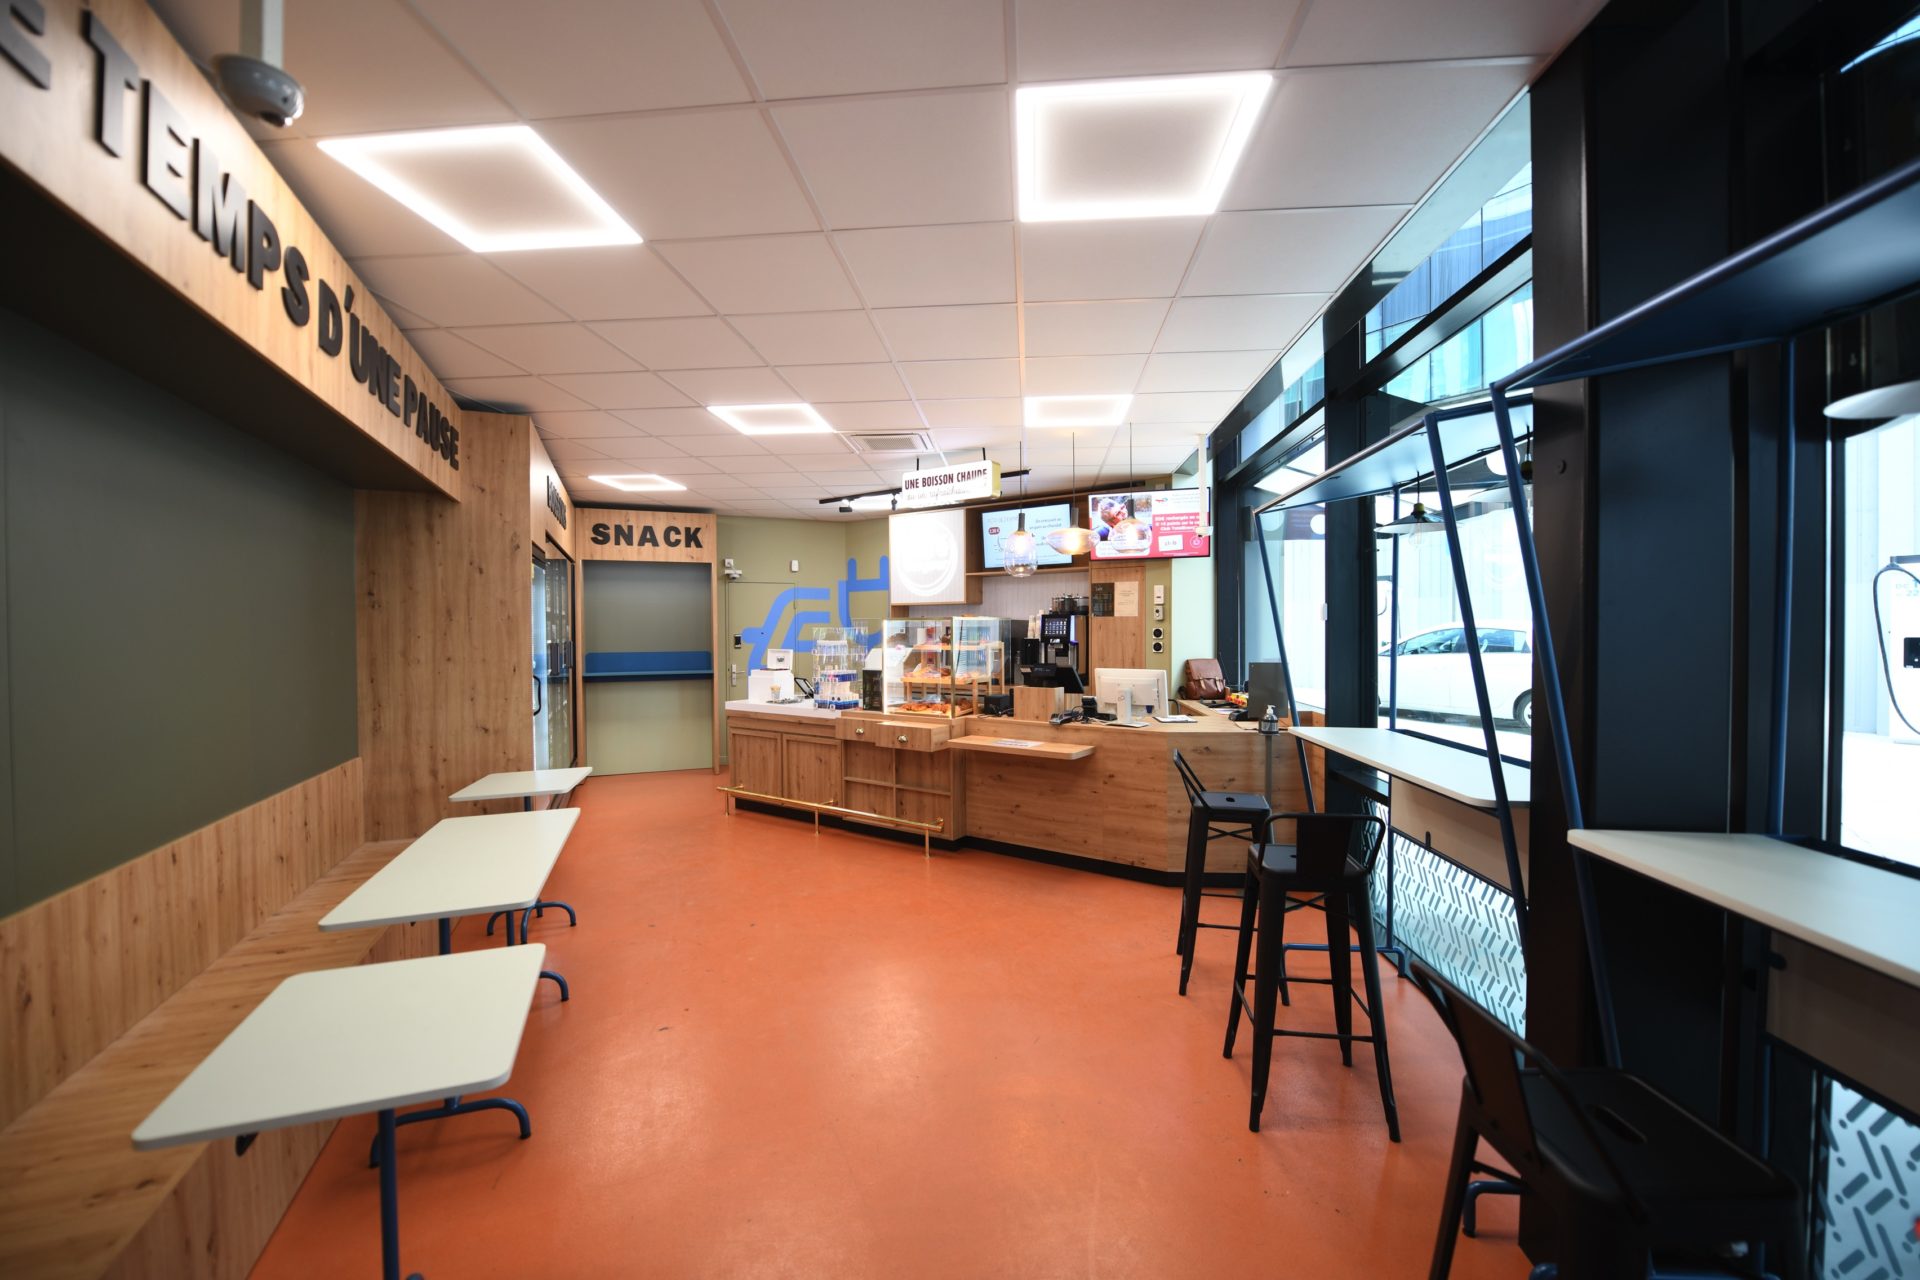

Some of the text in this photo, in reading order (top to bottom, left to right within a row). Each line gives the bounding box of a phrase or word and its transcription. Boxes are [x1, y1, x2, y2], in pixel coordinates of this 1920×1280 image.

[80, 9, 310, 328] TEMPS
[317, 278, 402, 418] D'UNE
[403, 373, 460, 471] PAUSE
[904, 478, 920, 490] UNE
[921, 473, 954, 488] BOISSON
[590, 523, 704, 549] SNACK
